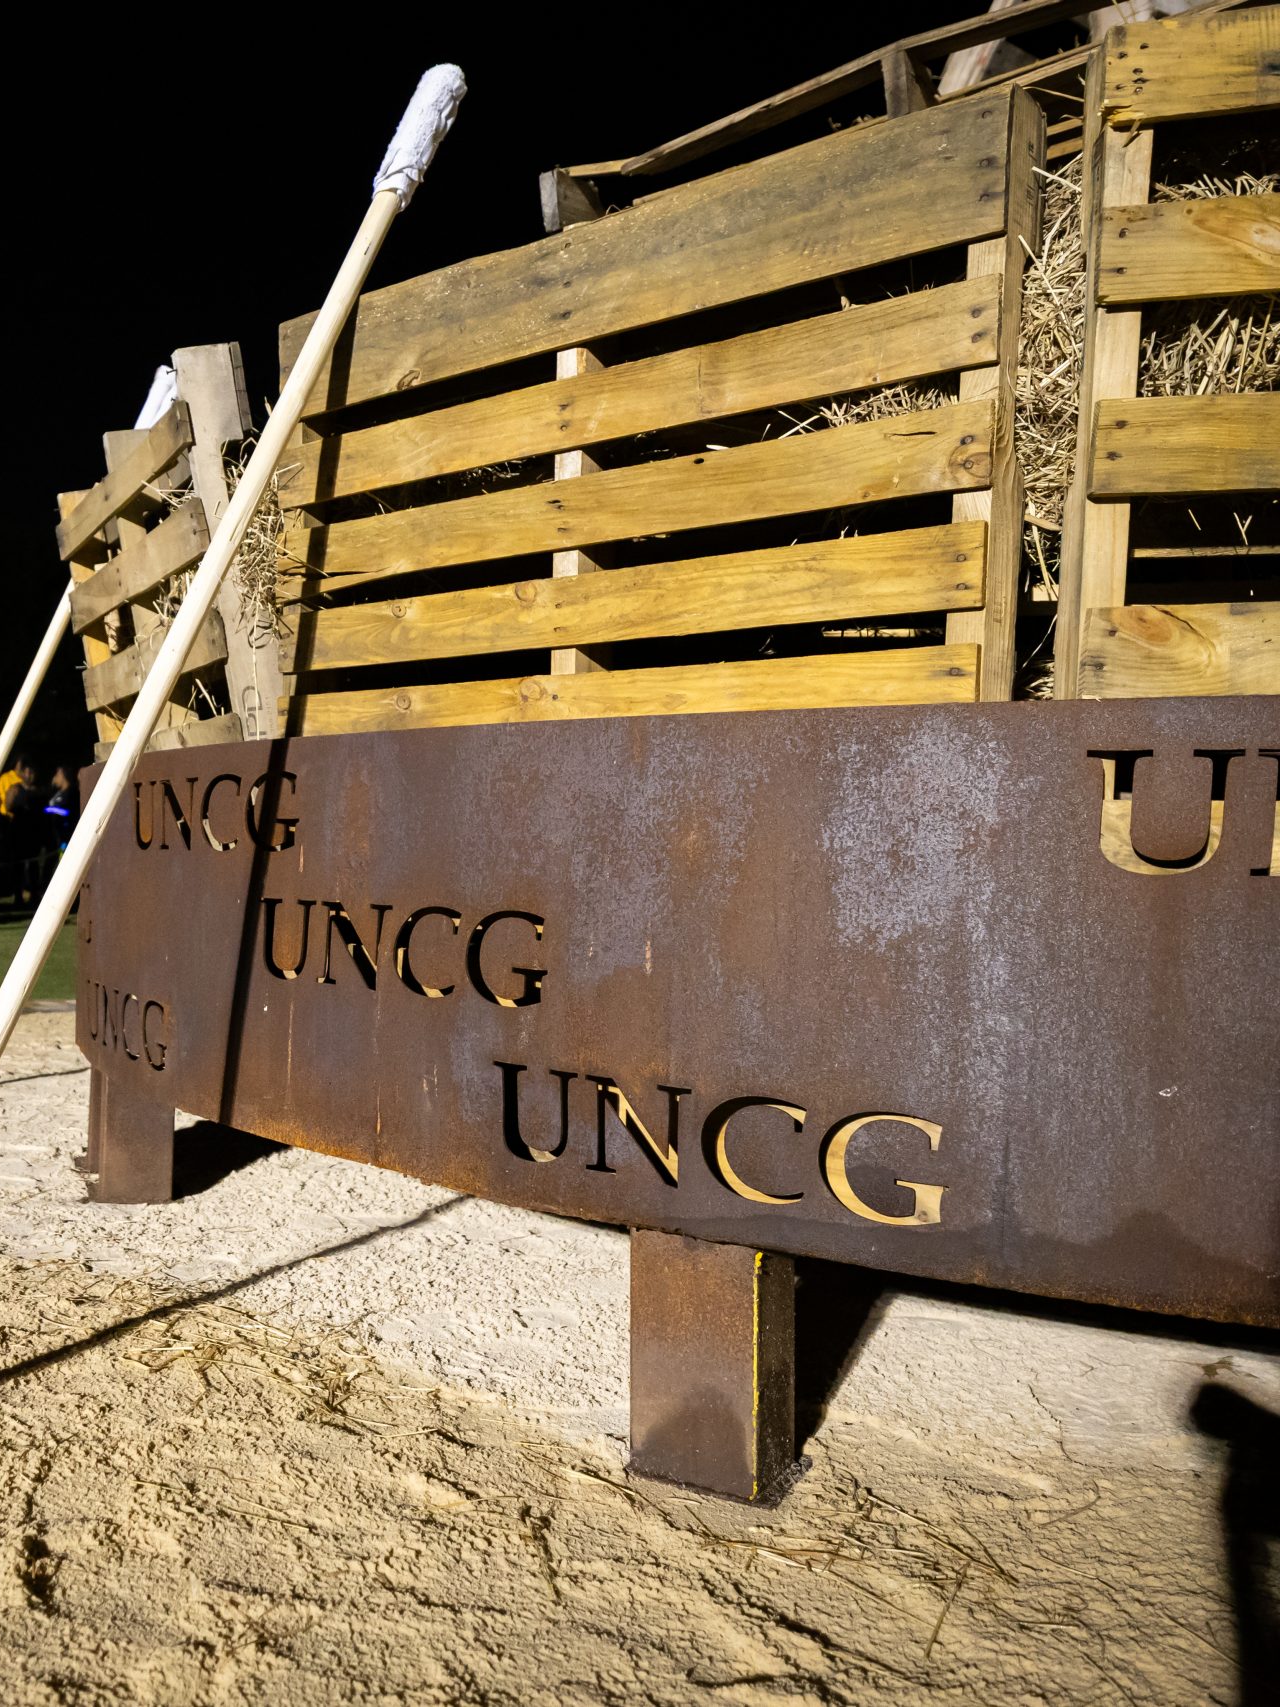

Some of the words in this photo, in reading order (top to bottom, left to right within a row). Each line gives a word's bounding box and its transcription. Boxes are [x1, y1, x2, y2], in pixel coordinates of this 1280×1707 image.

[133, 771, 300, 852] UNCG
[1087, 749, 1280, 876] U
[259, 898, 548, 1008] UNCG
[87, 979, 168, 1071] UNCG
[494, 1060, 950, 1227] UNCG
